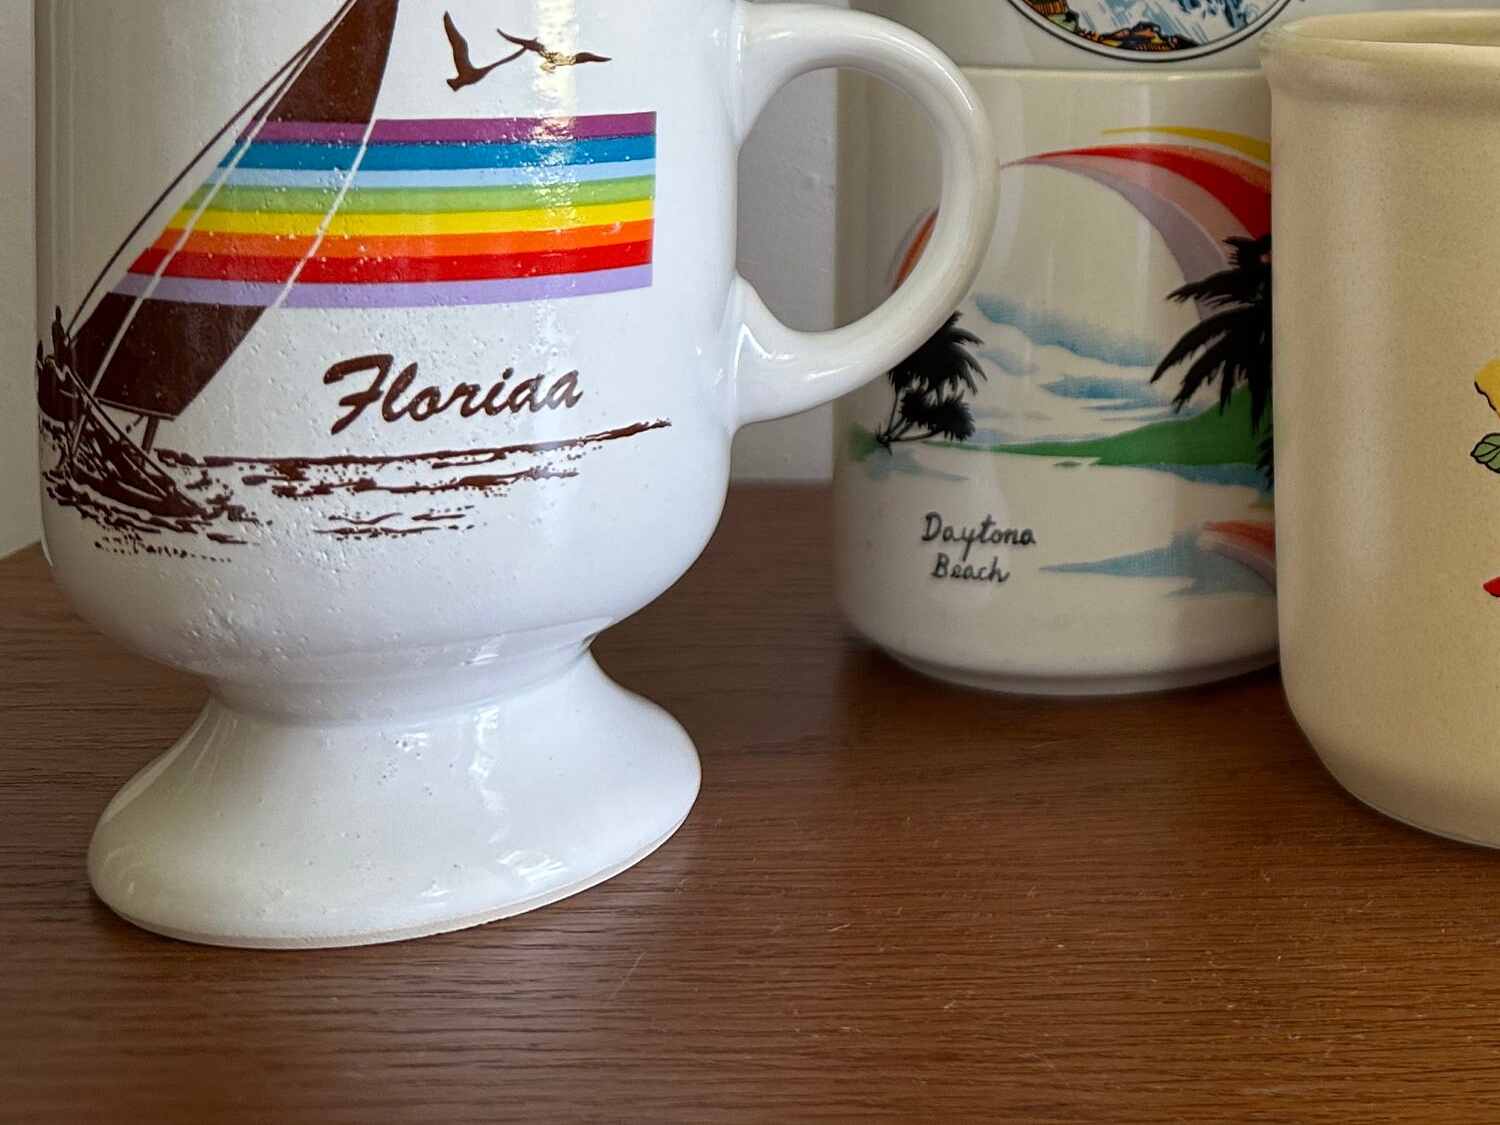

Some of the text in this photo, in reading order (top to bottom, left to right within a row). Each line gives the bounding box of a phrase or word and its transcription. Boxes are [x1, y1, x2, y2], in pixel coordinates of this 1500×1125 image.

[322, 353, 585, 436] Florida
[920, 511, 1037, 561] Daytona
[930, 552, 1011, 584] Beach
